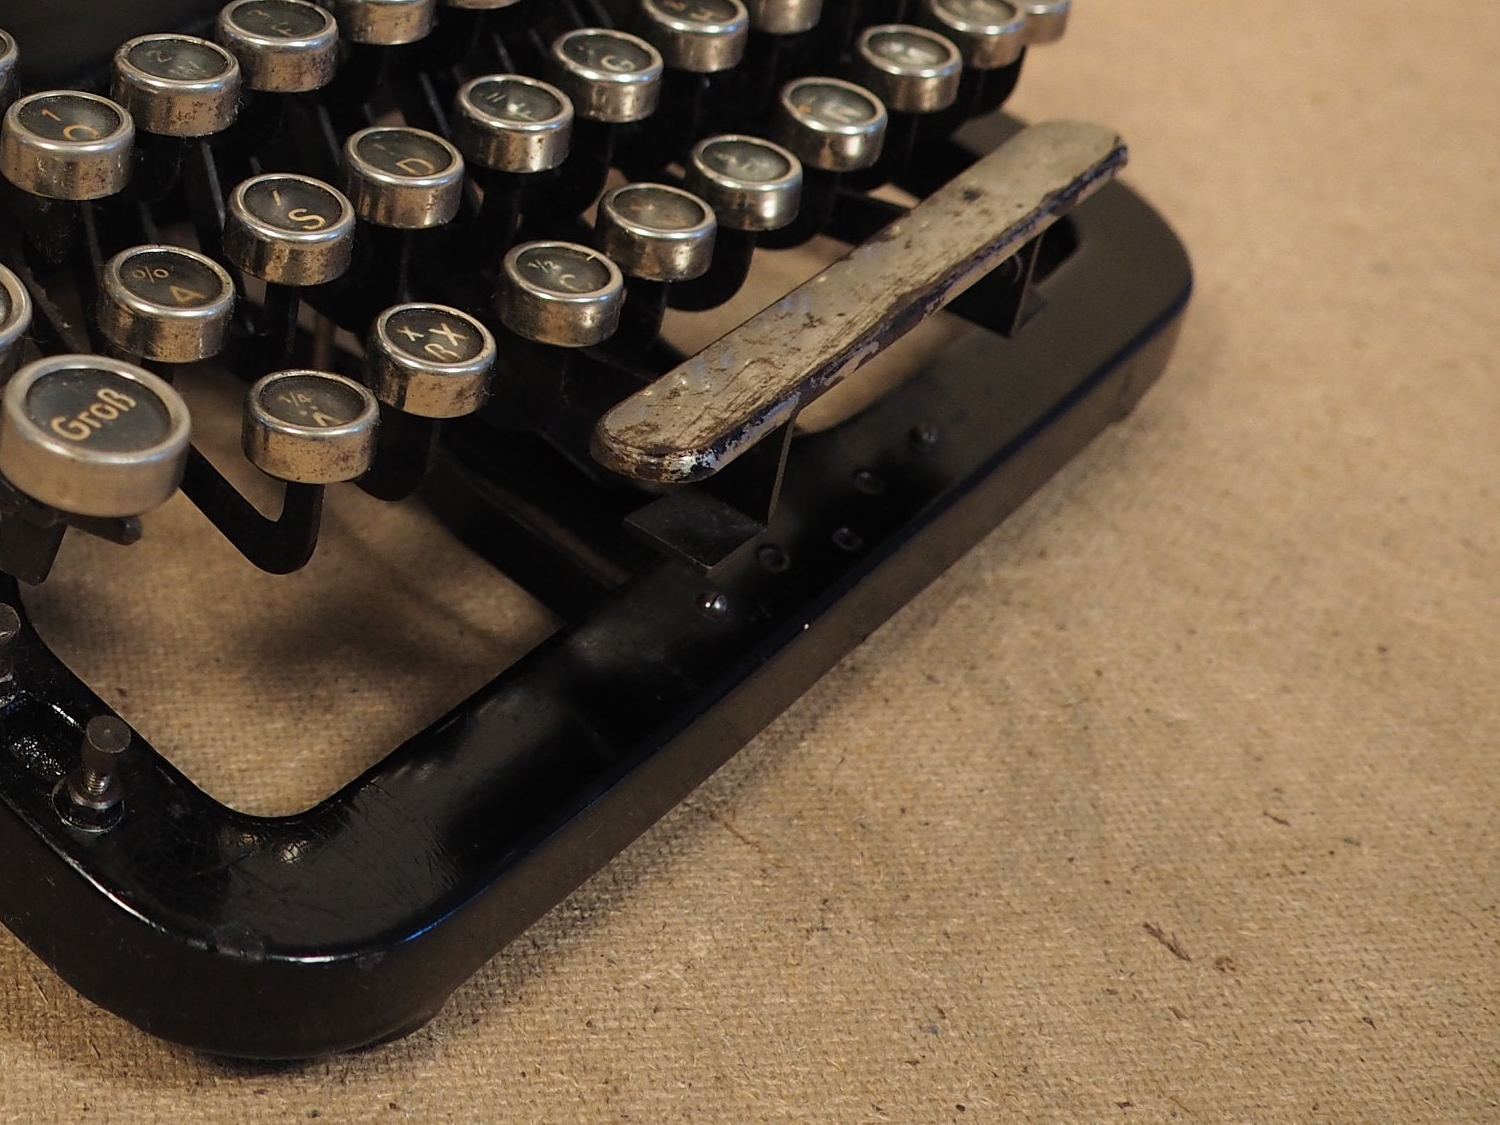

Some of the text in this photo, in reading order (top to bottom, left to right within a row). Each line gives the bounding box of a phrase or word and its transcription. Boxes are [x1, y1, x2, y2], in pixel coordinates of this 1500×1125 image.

[287, 207, 326, 231] S
[169, 284, 209, 305] A
[427, 322, 469, 348] X
[51, 387, 138, 442] Groß
